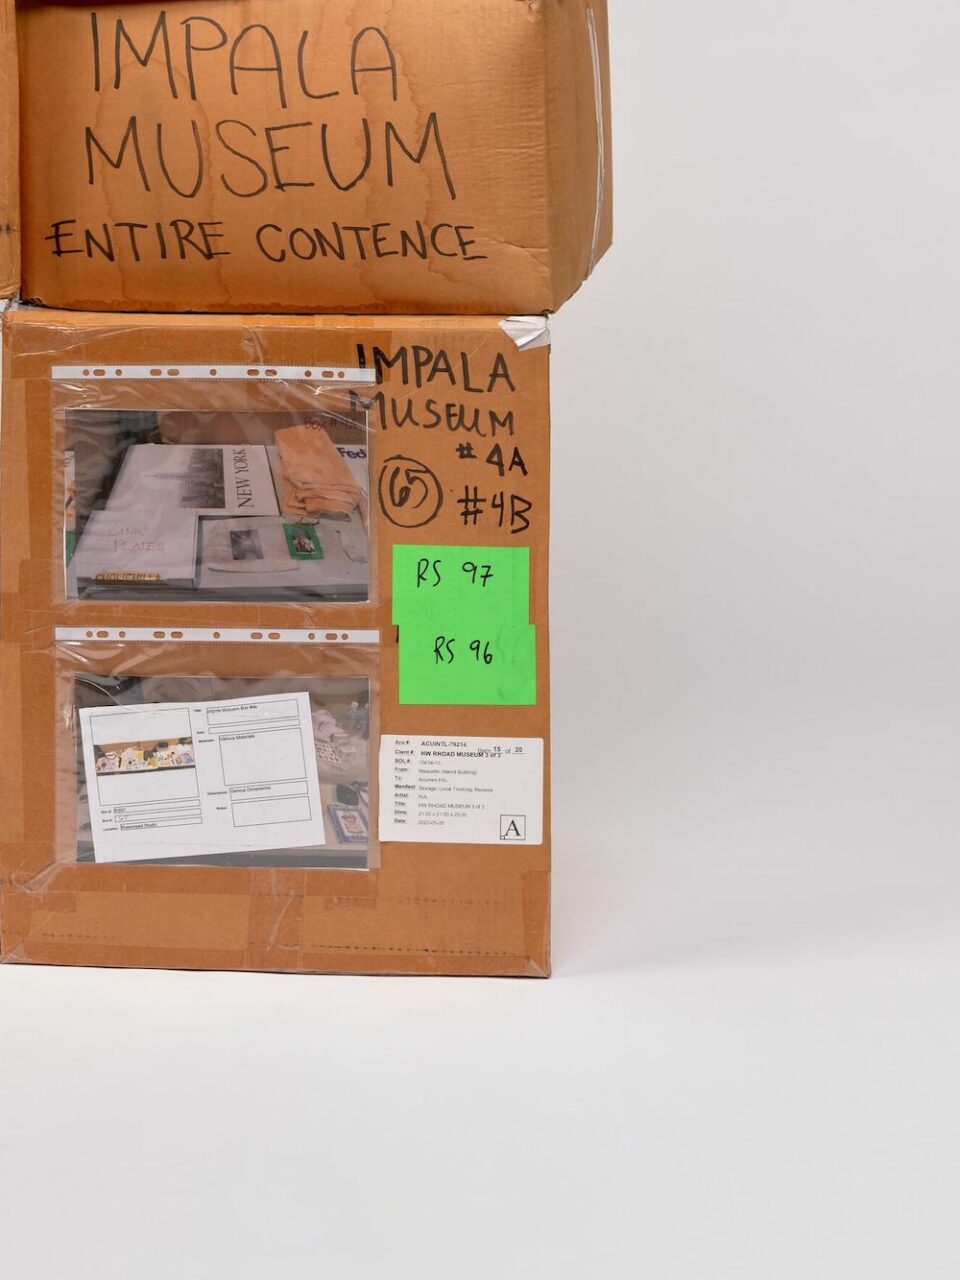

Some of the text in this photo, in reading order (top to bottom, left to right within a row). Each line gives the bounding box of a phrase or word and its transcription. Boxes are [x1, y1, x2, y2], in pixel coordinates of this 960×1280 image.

[92, 11, 398, 109] IMPALA
[85, 111, 457, 201] MUSEUM
[44, 219, 489, 263] ENTIRE CONTENCE
[356, 344, 516, 394] IMPALA
[349, 389, 515, 437] MUSEUM
[232, 448, 254, 509] NEW YORK
[390, 466, 429, 509] 65
[416, 558, 494, 588] RS 97
[433, 636, 493, 665] RS 96
